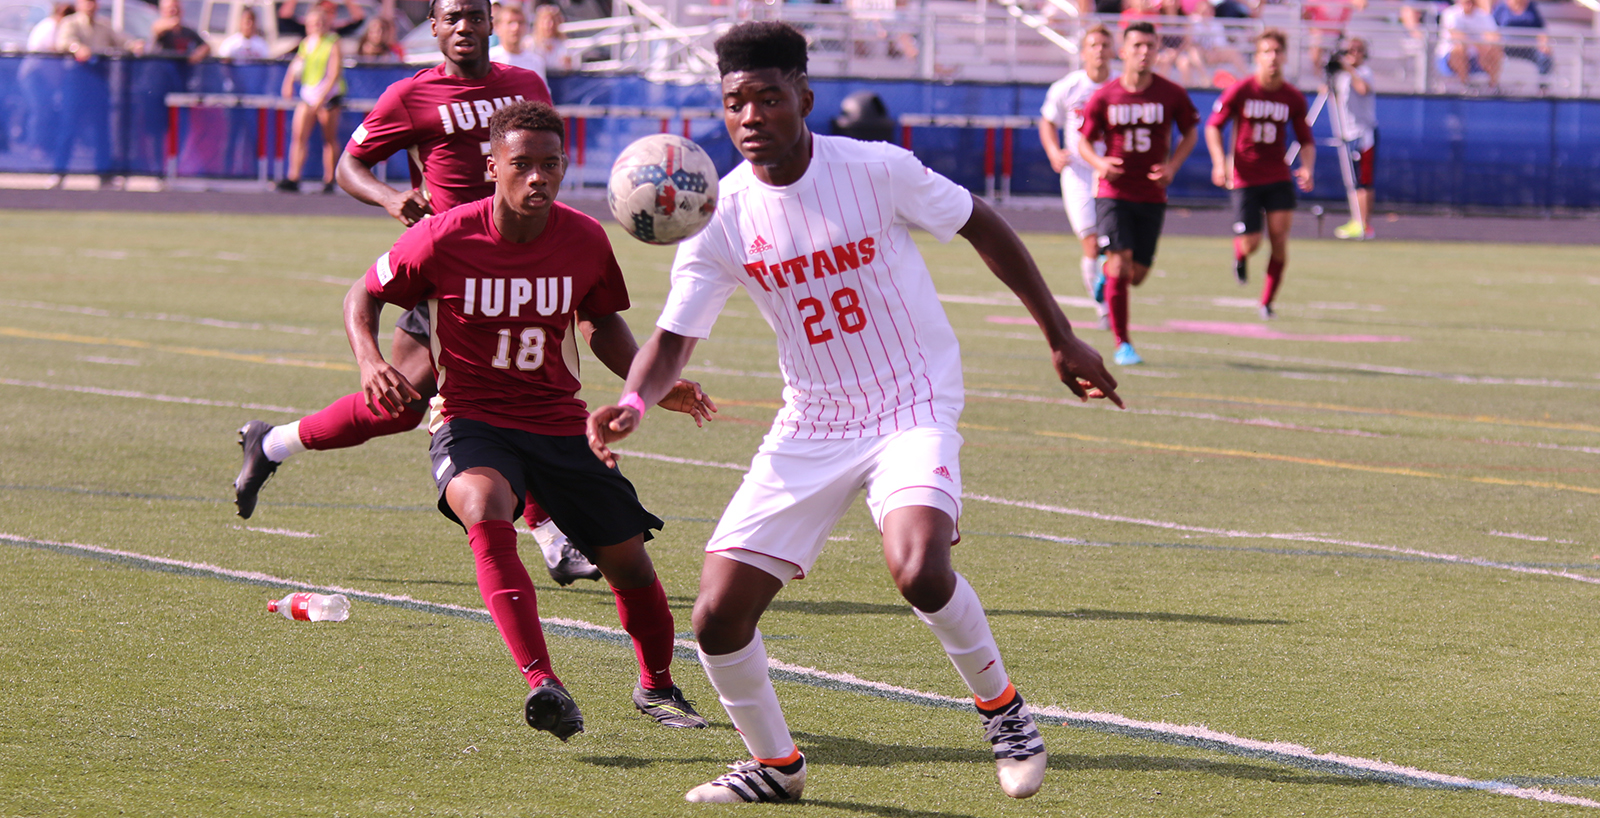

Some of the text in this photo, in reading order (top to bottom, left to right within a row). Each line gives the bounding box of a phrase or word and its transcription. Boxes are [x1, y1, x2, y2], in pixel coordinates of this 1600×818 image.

[437, 95, 526, 135] IUP
[1107, 102, 1164, 126] IUPUI
[1243, 98, 1290, 123] IUPUI
[1123, 127, 1152, 153] 15
[743, 236, 876, 292] TITANS
[463, 276, 573, 317] IUPUI
[797, 287, 868, 345] 28
[491, 326, 547, 371] 18
